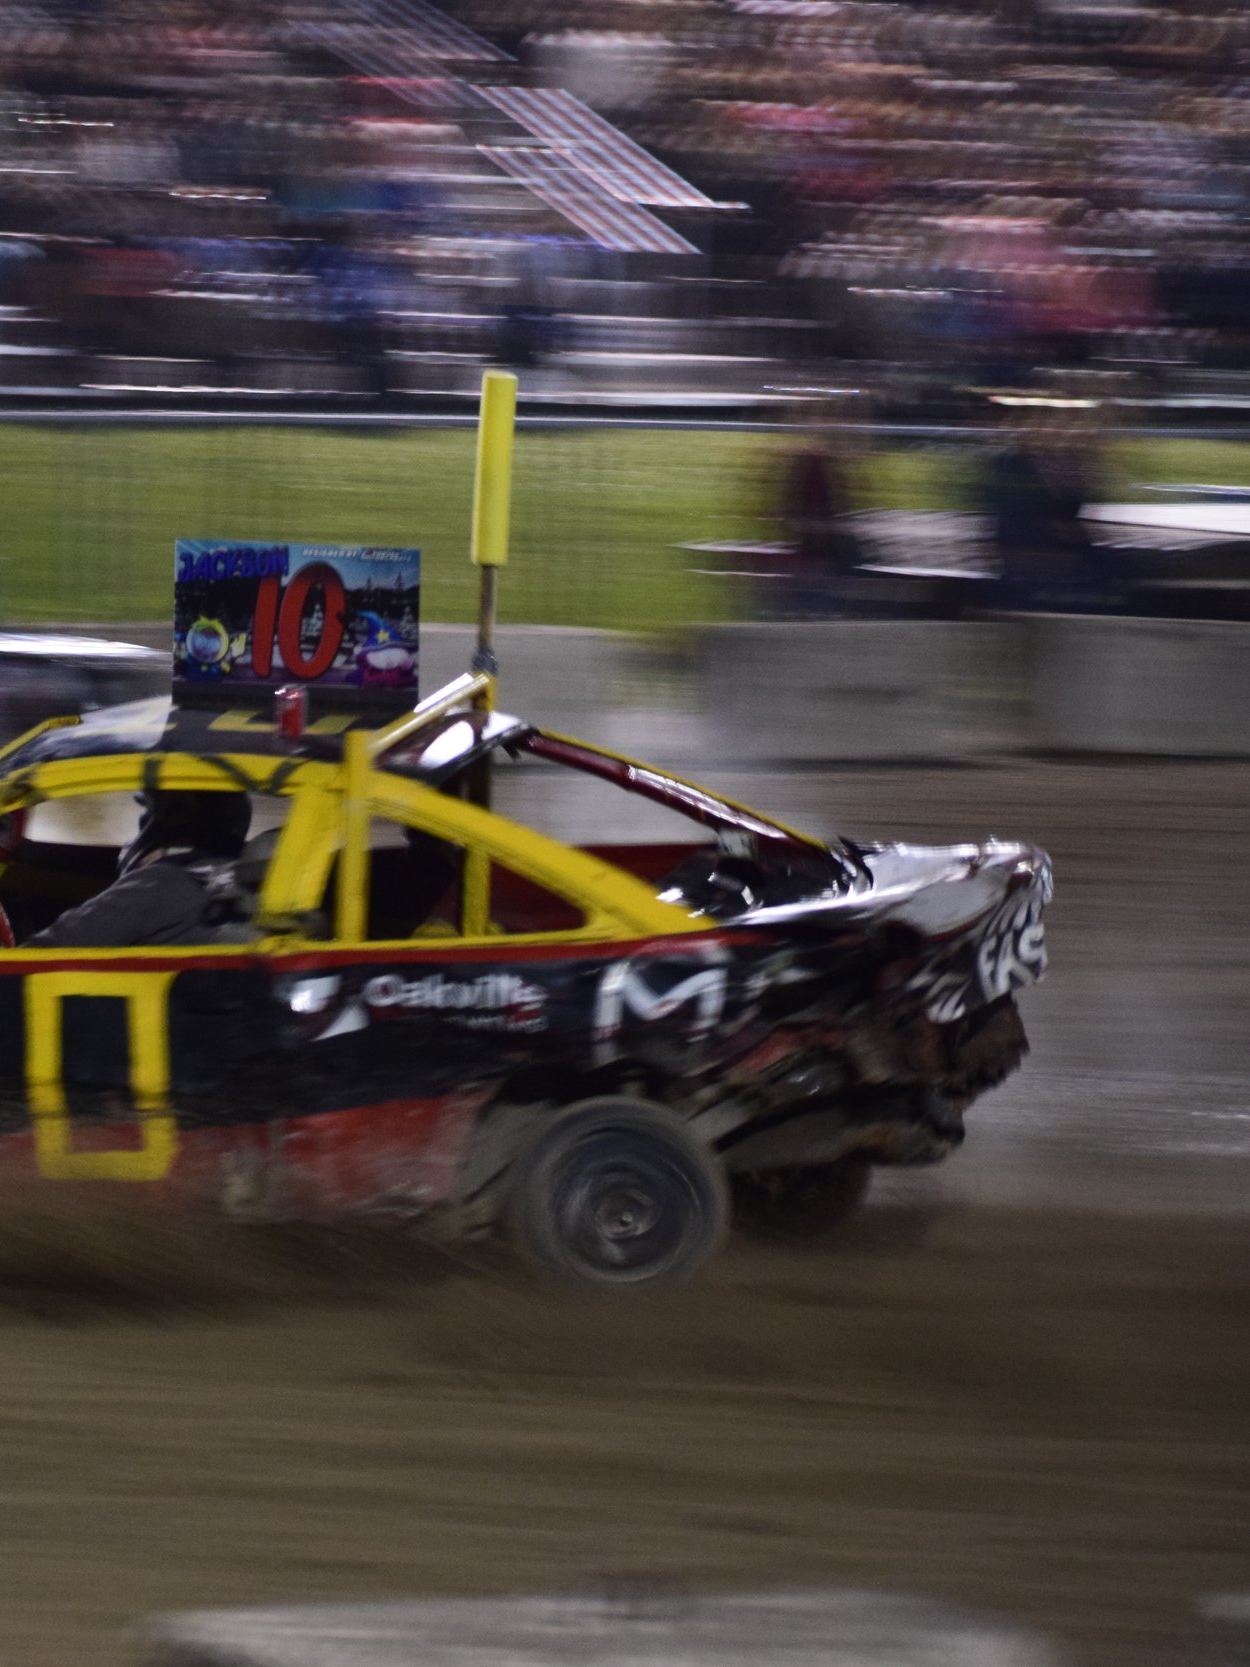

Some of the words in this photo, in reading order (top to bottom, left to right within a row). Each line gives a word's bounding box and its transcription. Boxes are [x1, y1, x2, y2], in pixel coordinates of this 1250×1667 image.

[178, 545, 289, 582] JACKSON
[252, 560, 347, 679] 10
[363, 973, 549, 1010] Oakville
